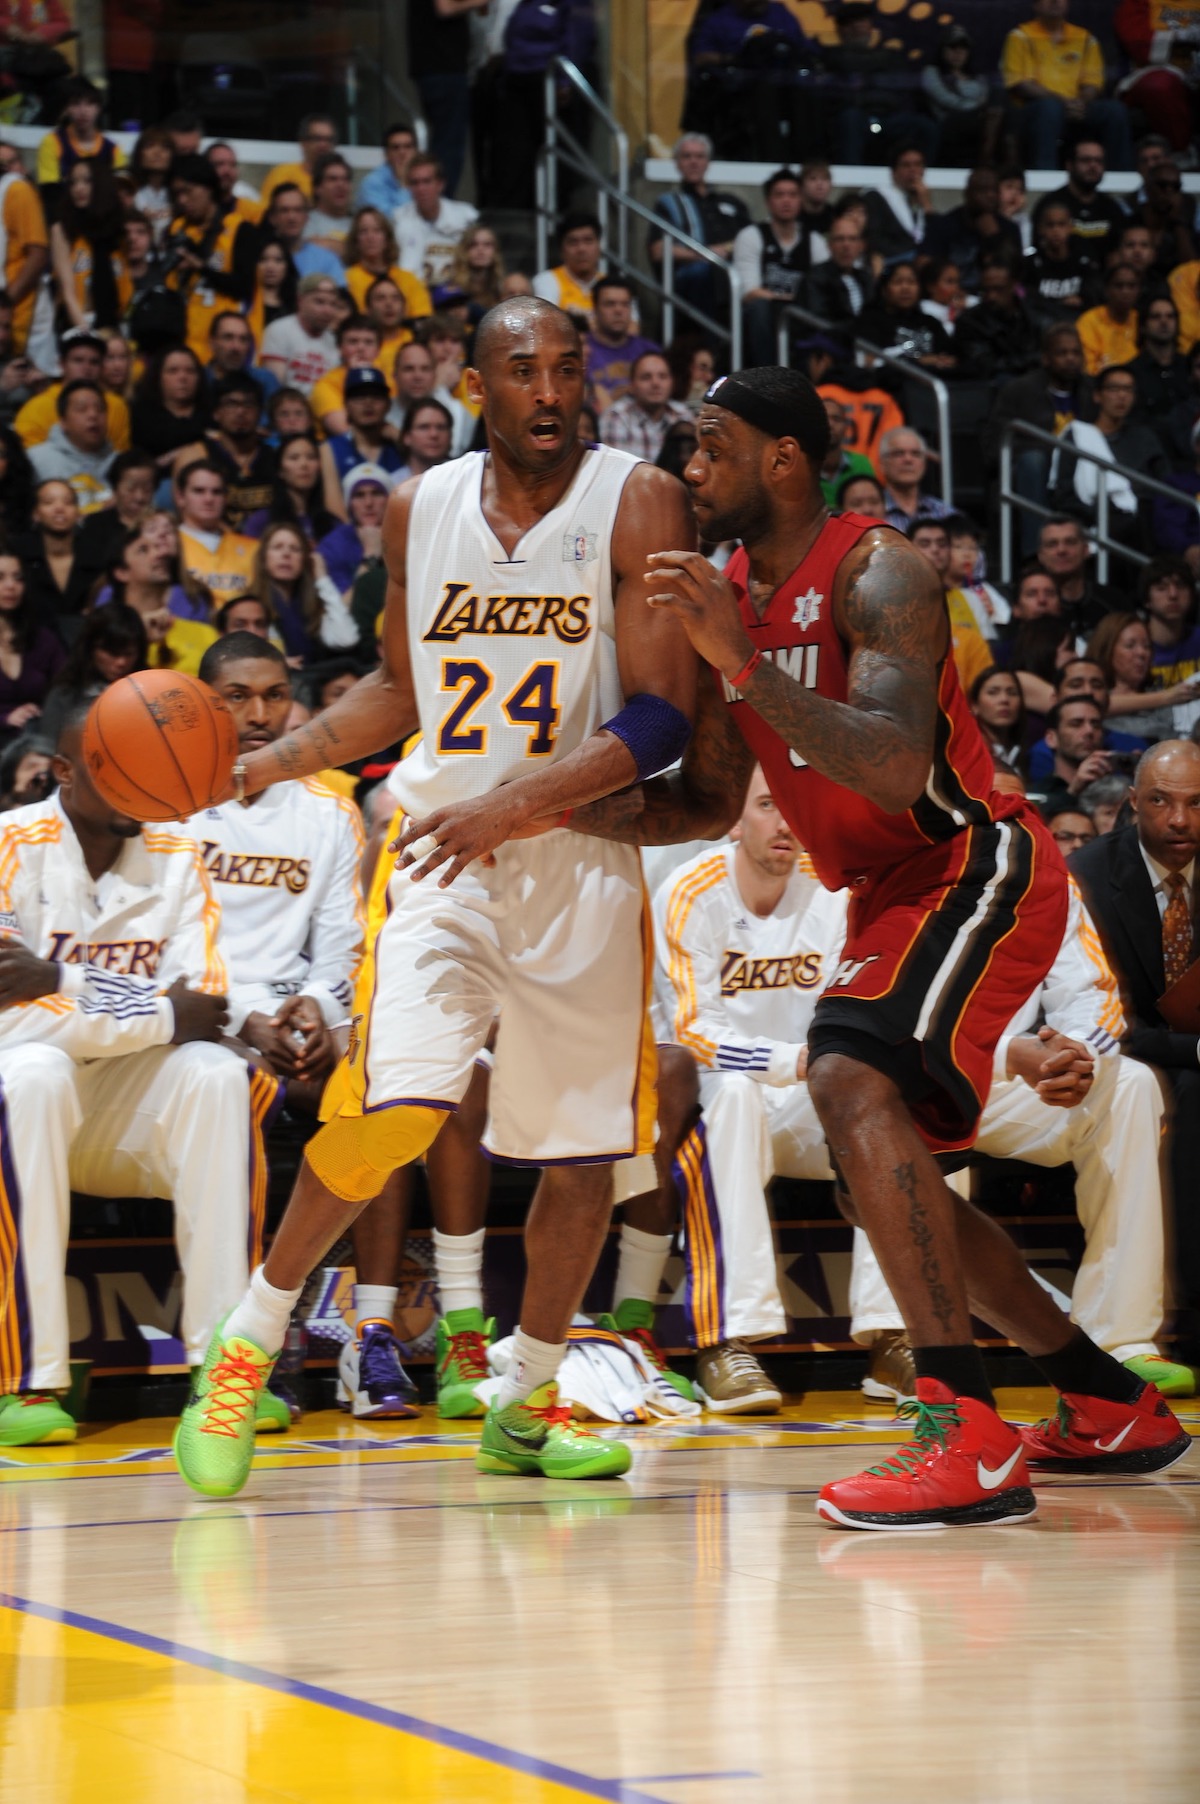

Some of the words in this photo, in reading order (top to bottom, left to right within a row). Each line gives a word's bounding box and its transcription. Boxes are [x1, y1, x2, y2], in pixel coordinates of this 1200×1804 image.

[421, 582, 592, 645] LAKERS
[435, 657, 562, 757] 24
[720, 948, 826, 998] LAKERS
